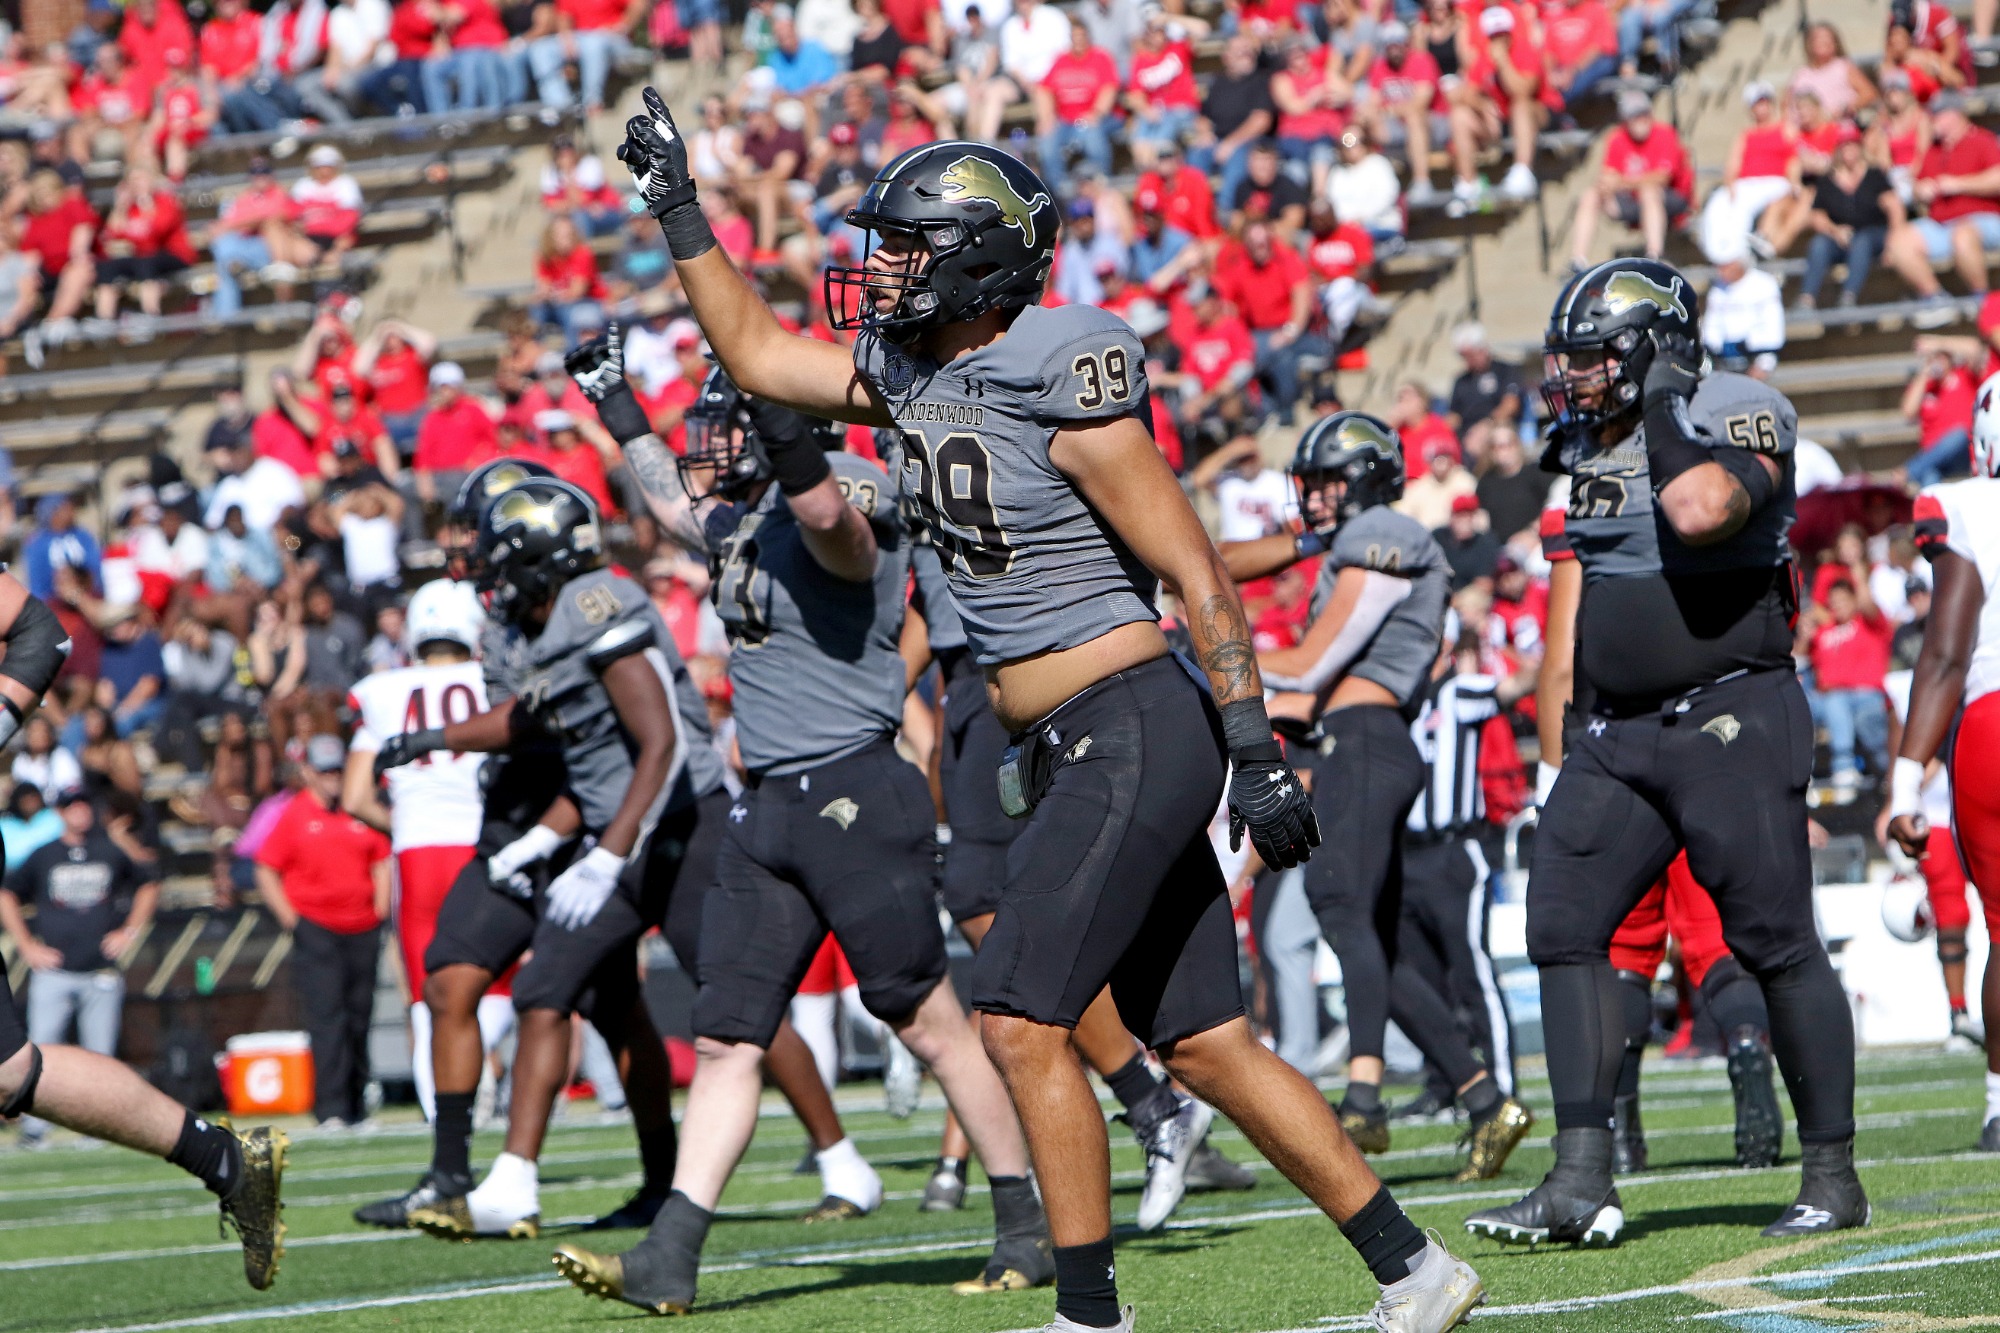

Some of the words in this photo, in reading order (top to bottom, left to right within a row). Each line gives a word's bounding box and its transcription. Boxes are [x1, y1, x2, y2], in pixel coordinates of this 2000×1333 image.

[1071, 344, 1131, 412] 39
[894, 402, 984, 427] LINDENWOOD
[1725, 409, 1779, 455] 56
[900, 429, 1016, 579] 39
[576, 583, 624, 625] 91
